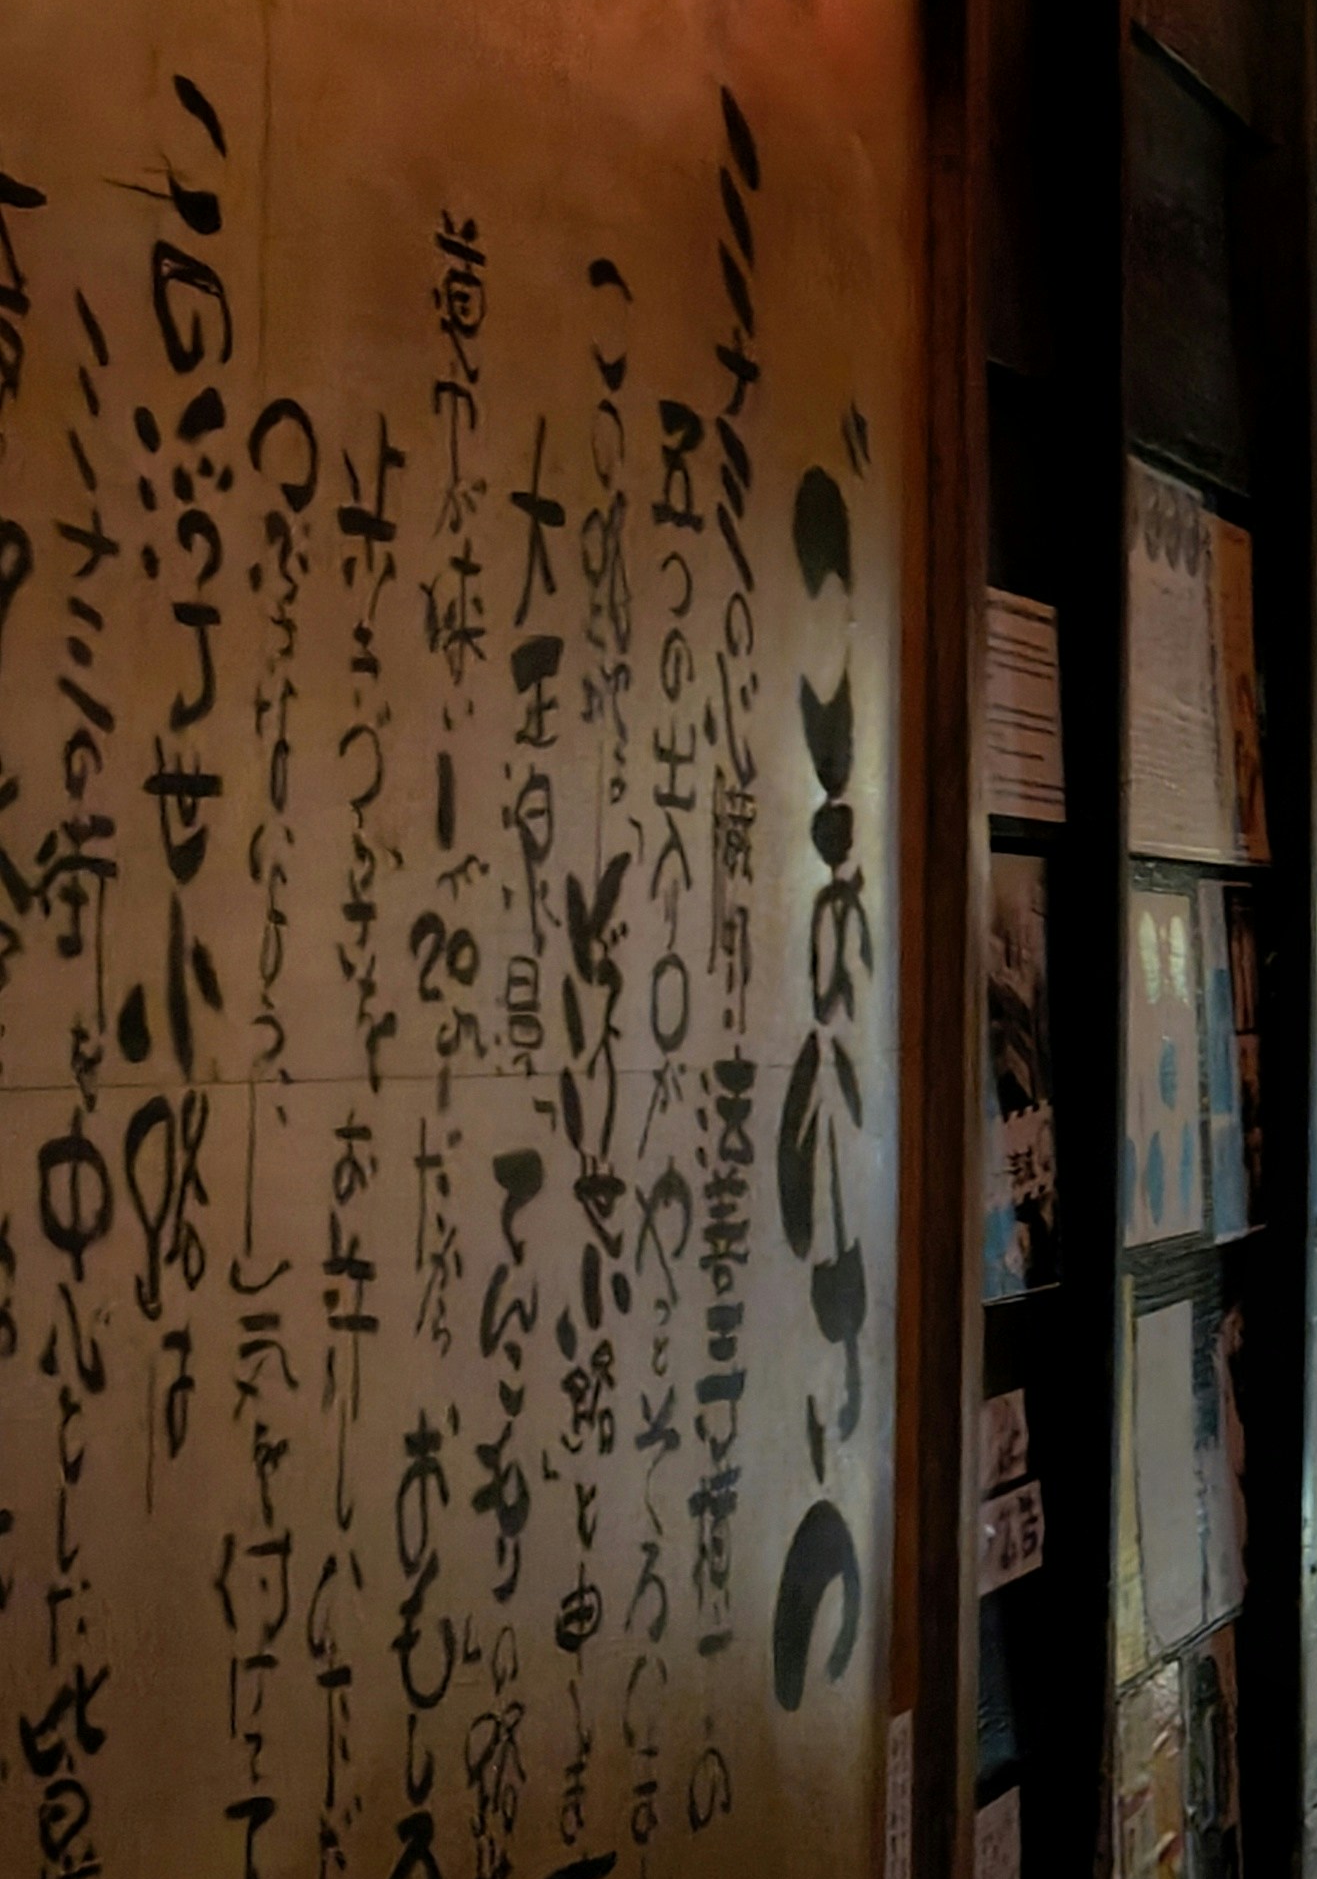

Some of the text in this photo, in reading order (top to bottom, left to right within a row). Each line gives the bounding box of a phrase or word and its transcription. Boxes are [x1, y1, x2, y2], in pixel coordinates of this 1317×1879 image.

[772, 402, 872, 1714] ごあいさつ
